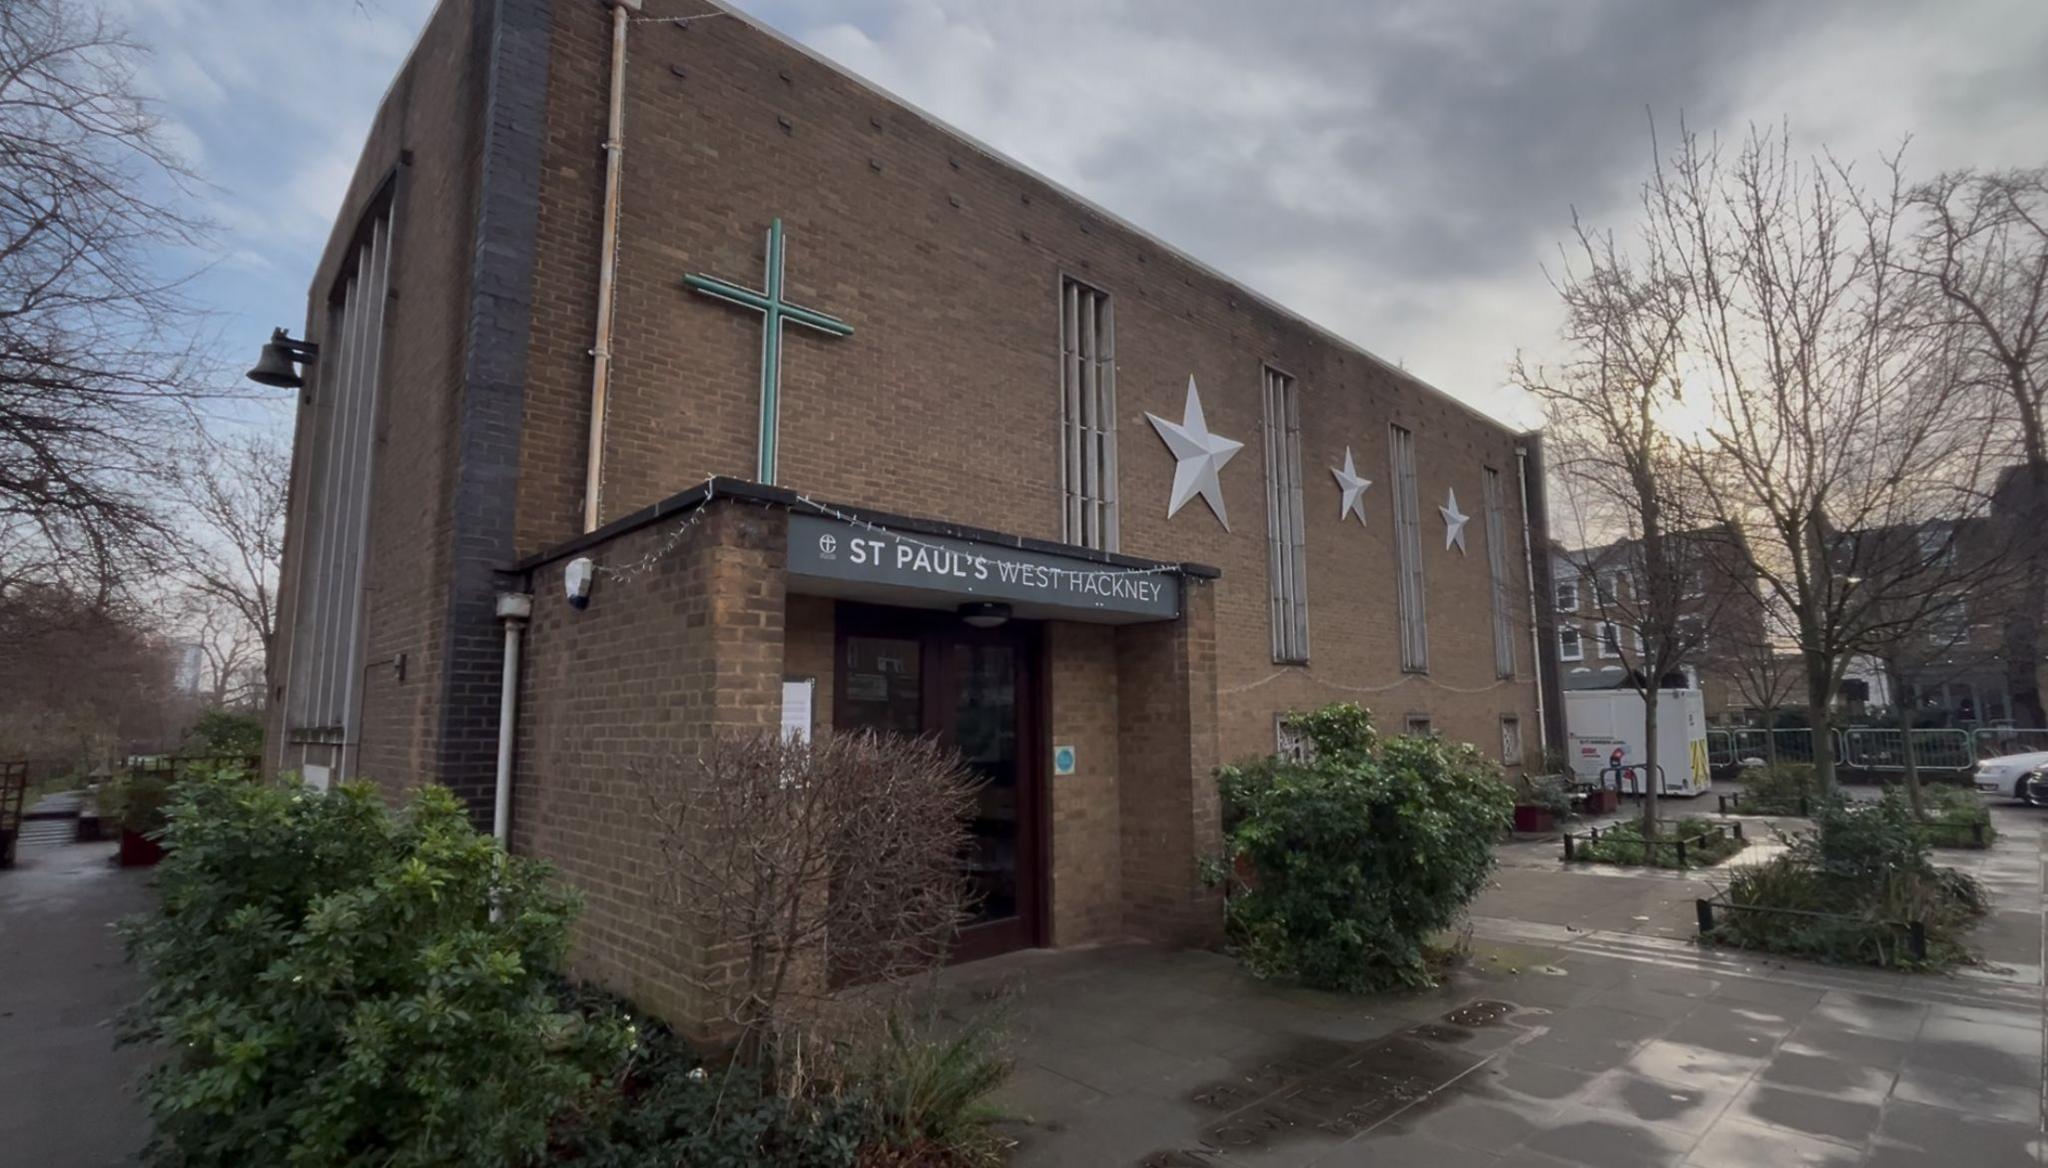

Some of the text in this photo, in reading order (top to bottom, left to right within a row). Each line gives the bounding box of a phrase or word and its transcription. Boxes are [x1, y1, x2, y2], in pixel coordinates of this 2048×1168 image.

[850, 539, 1162, 602] ST PAUL'S WEST HACKNEY
